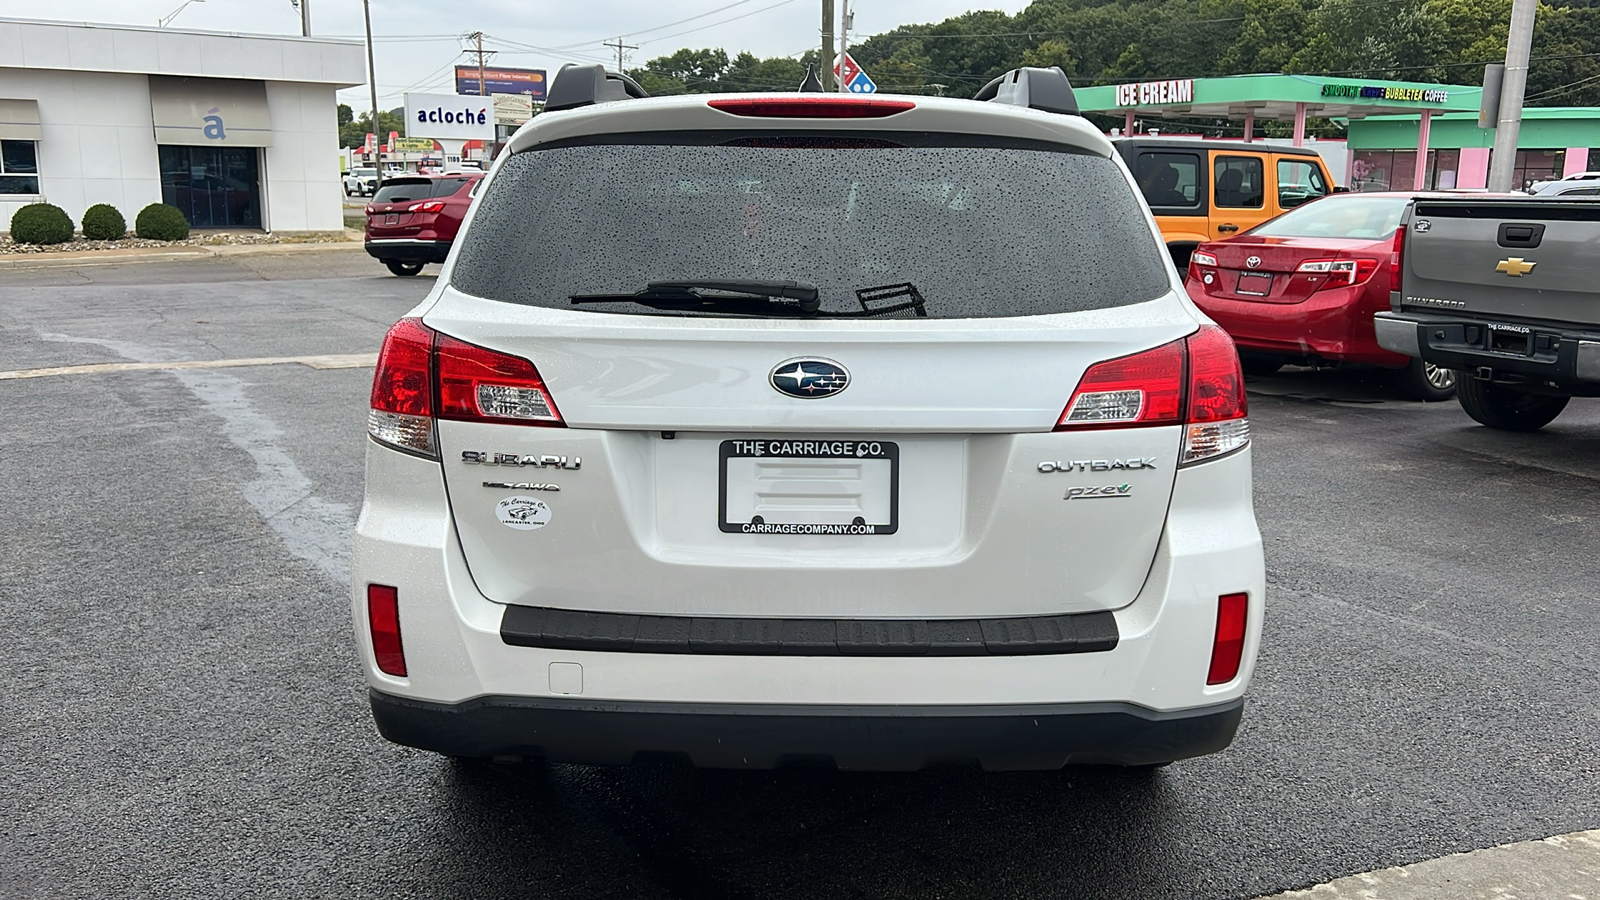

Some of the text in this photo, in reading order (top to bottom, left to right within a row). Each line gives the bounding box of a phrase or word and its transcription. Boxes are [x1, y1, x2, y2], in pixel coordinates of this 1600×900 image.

[1115, 79, 1193, 107] ICE CREAM
[1385, 87, 1423, 101] BUBBLETEA
[1424, 90, 1448, 103] COFFEE
[203, 107, 226, 140] á
[417, 107, 487, 125] acloché
[1406, 296, 1465, 308] SILVERADO
[1497, 324, 1521, 332] CARRIAGE
[732, 441, 885, 455] THE CARRIAGE CO.
[461, 450, 582, 470] SUBARU
[1037, 456, 1157, 473] OUTBACK
[511, 498, 536, 507] Carriage
[741, 523, 875, 534] CARRIAGECOMPANY.COM
